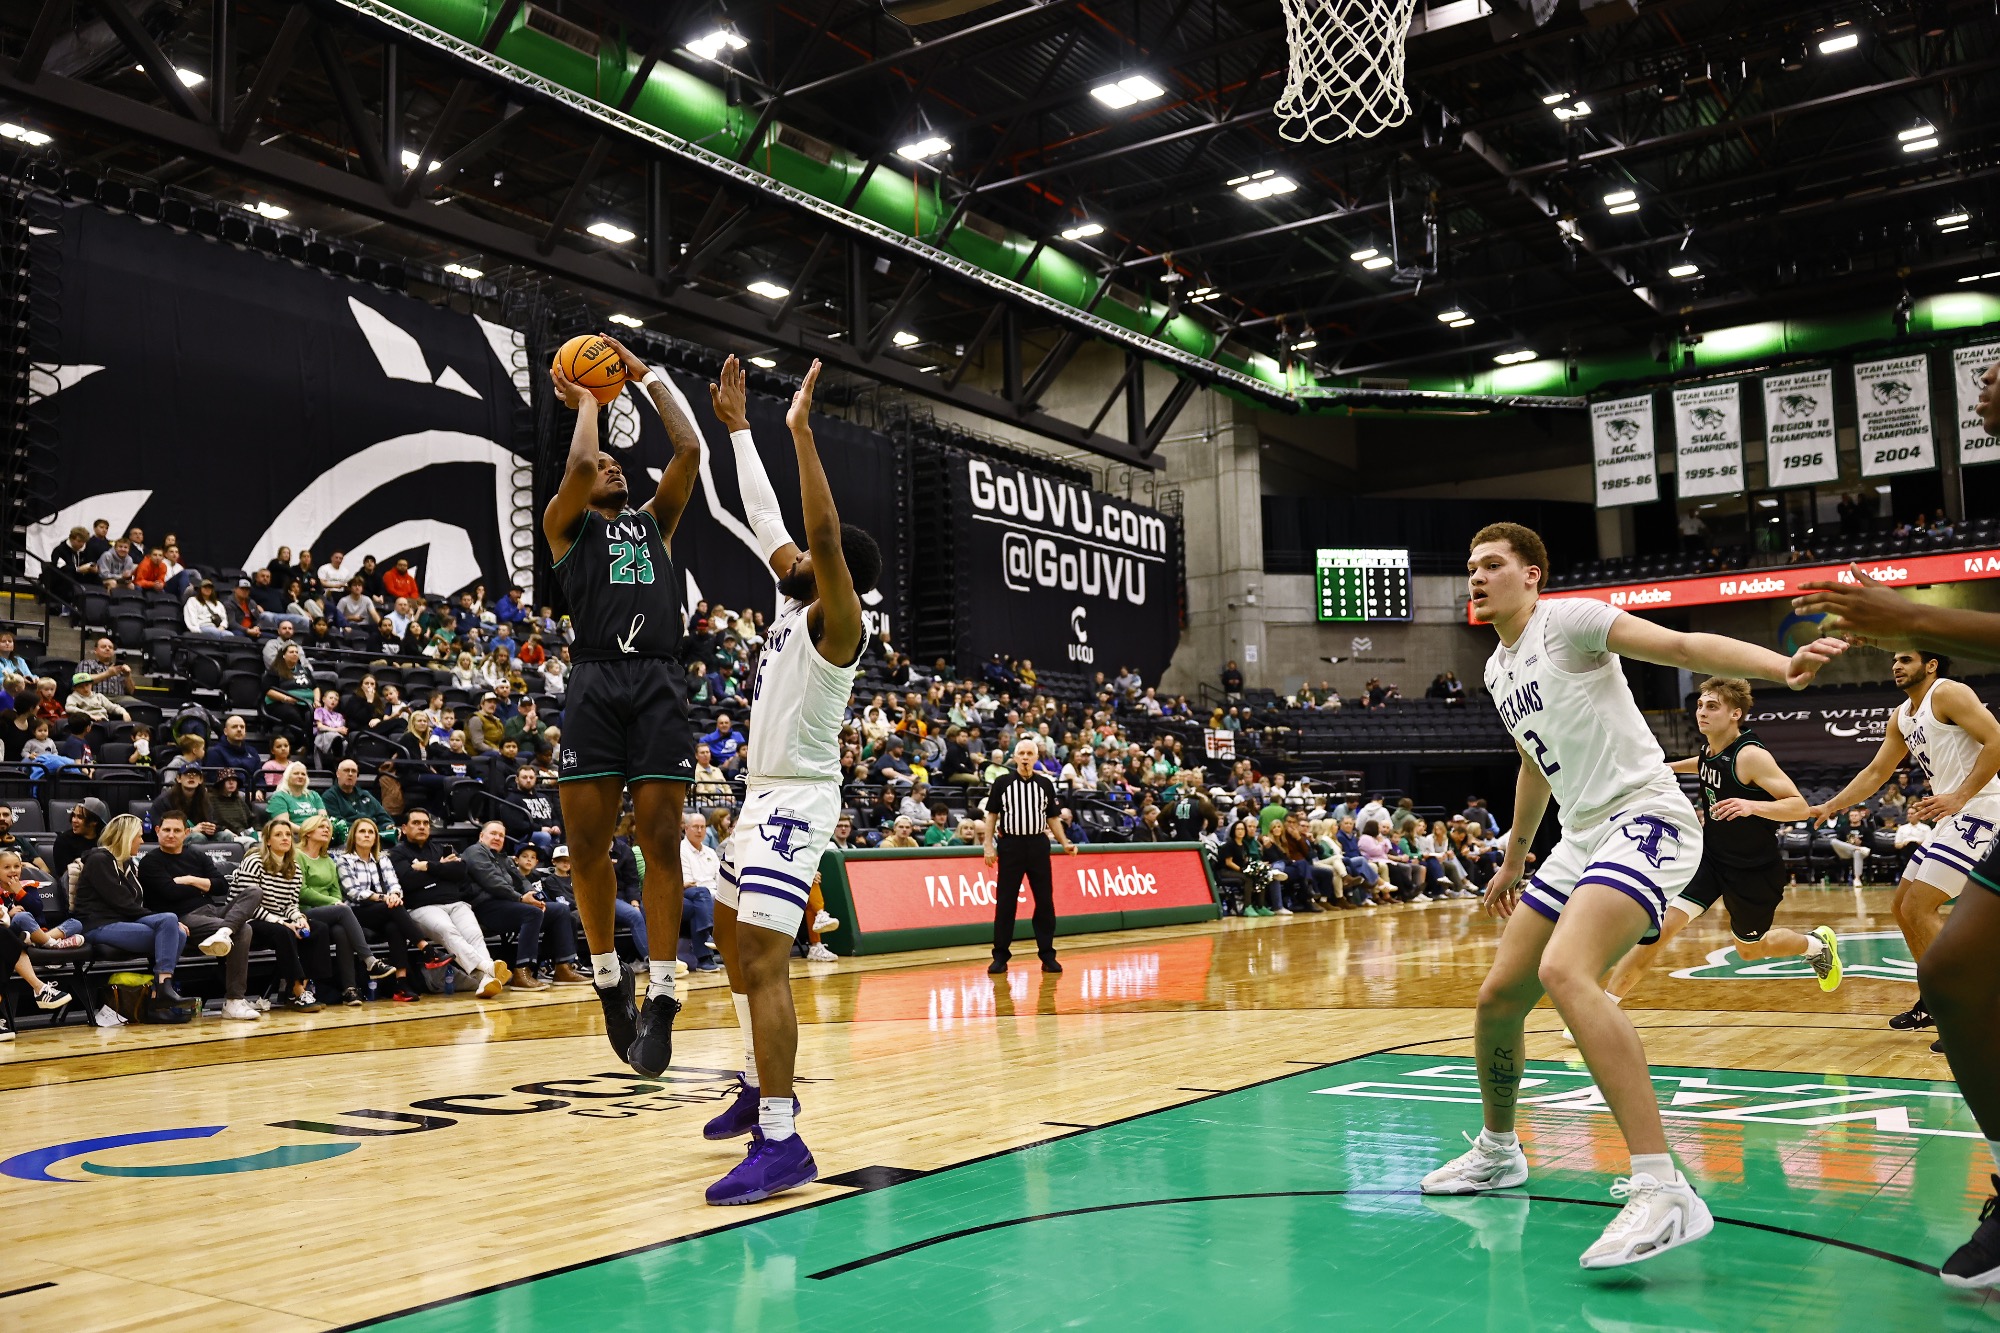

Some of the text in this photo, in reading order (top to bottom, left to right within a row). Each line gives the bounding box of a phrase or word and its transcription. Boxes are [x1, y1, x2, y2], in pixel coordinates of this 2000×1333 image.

[1956, 350, 1984, 360] UTAH
[1857, 358, 1924, 375] UTAH VALLEY
[1766, 374, 1828, 388] UTAH VALLEY
[1676, 387, 1736, 401] UTAH VALLEY
[1619, 399, 1649, 409] VALLEY
[1772, 419, 1829, 432] REGION 18
[1862, 425, 1929, 441] CHAMPIONS
[1691, 431, 1727, 444] SWAC
[1770, 429, 1832, 443] CHAMPIONS
[1611, 443, 1637, 455] ICAC
[1680, 442, 1739, 455] CHAMPIONS
[1874, 446, 1921, 463] 2004
[1597, 452, 1653, 467] CHAMPIONS
[1783, 453, 1823, 469] 1996
[1685, 465, 1738, 479] 1995-96
[1602, 475, 1652, 489] 1985-86
[968, 459, 1166, 553] GoUVU.com
[606, 522, 646, 541] UVU
[1002, 531, 1146, 605] @GoUVU
[1738, 577, 1785, 594] Adobe
[1627, 588, 1672, 605] Adobe
[1500, 681, 1543, 732] TEXANS
[1744, 711, 1811, 721] LOVE
[1524, 730, 1561, 776] 2
[1700, 762, 1721, 789] UVU
[1103, 866, 1158, 897] Adobe
